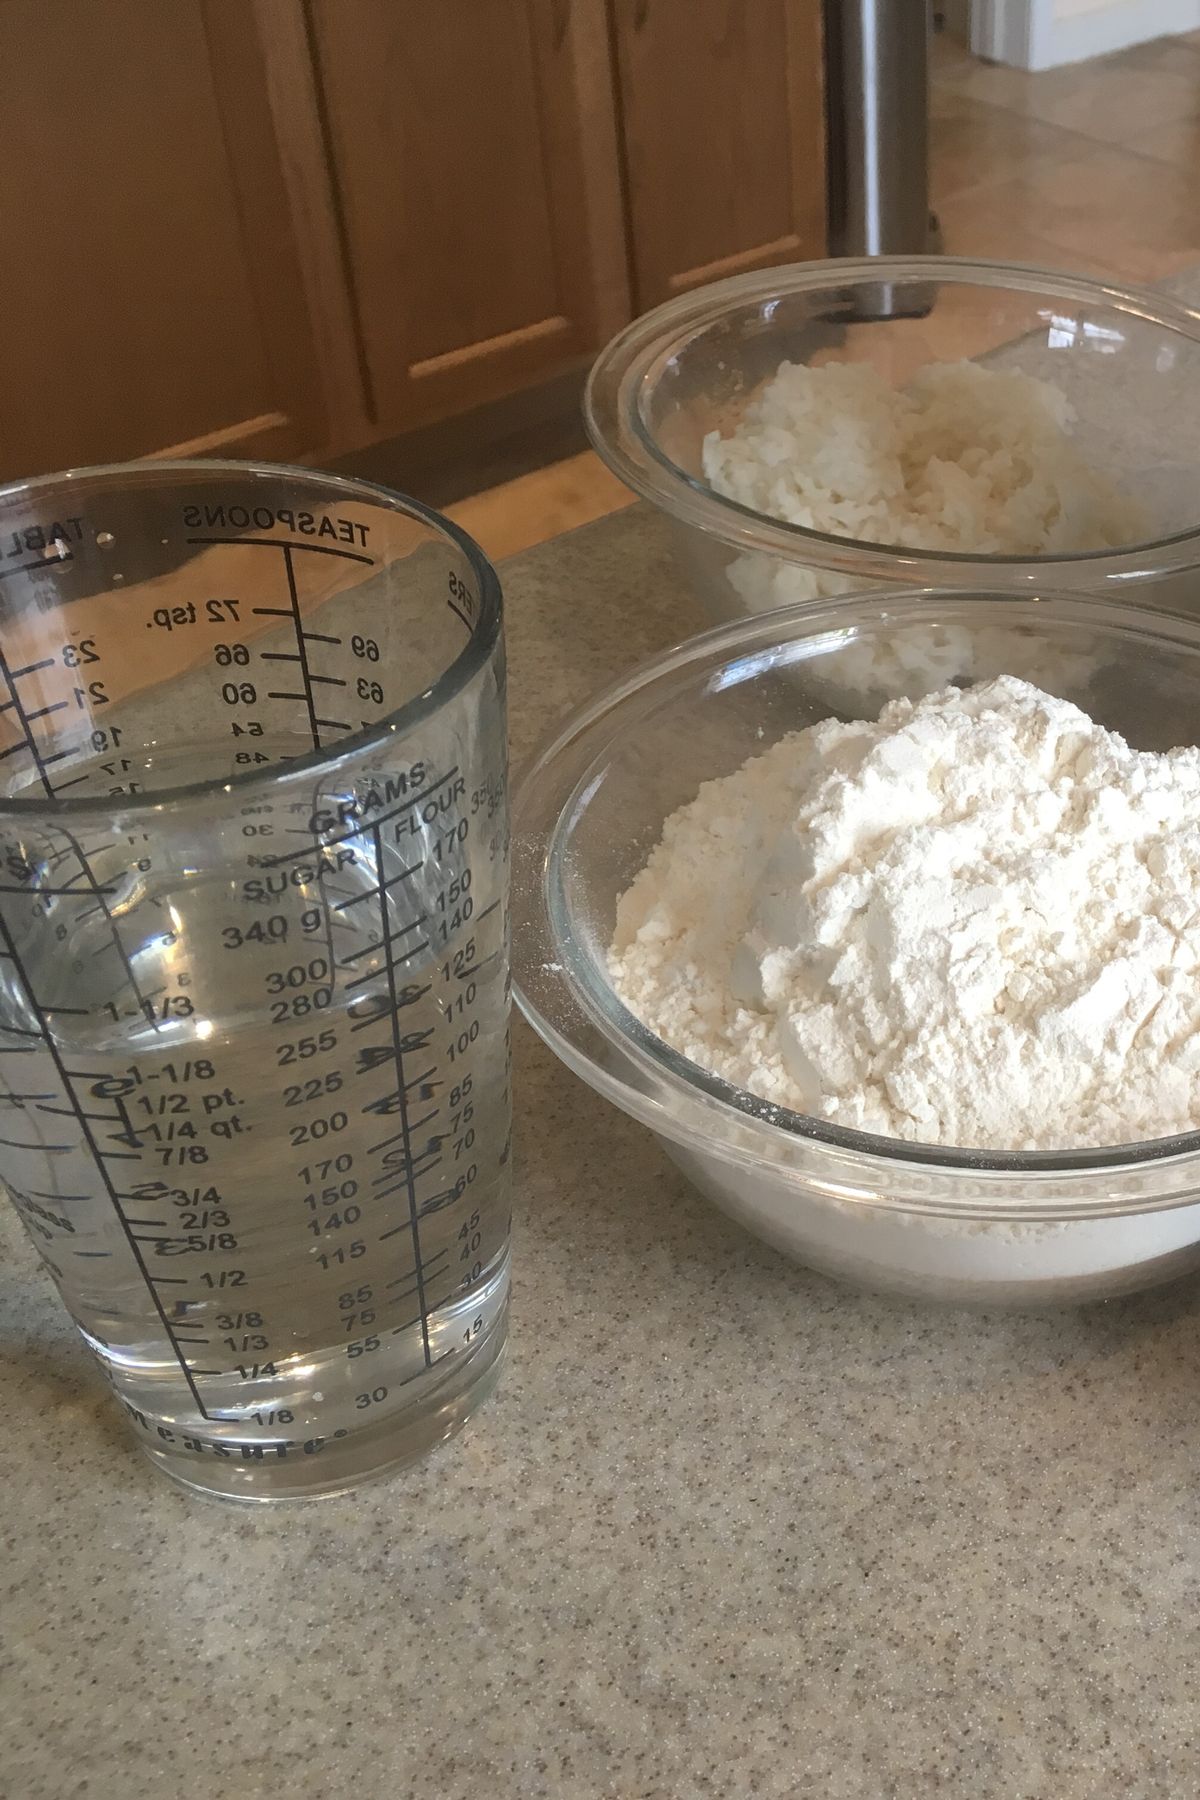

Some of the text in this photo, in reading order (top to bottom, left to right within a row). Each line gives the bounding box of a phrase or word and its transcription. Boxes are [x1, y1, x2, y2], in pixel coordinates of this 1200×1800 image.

[309, 761, 427, 835] GRAMS
[395, 777, 466, 843] FLOUR
[432, 817, 469, 862] 170
[243, 849, 358, 902] SUGAR
[436, 868, 472, 912] 150
[221, 916, 288, 950] 340
[301, 909, 322, 934] g
[438, 897, 474, 941] 140
[441, 937, 477, 982] 125
[265, 958, 328, 994] 300
[104, 996, 195, 1022] 1-1/3
[269, 987, 334, 1025] 280
[443, 982, 477, 1024] 110
[276, 1028, 337, 1066] 255
[446, 1020, 480, 1062] 100
[127, 1059, 216, 1085] 1-1/8
[138, 1087, 245, 1116] 1/2 pt.
[283, 1070, 344, 1108] 225
[449, 1073, 473, 1108] 85
[147, 1114, 253, 1142] 1/4 qt.
[288, 1111, 349, 1147] 200
[450, 1100, 474, 1134] 75
[154, 1146, 209, 1166] 7/8
[452, 1127, 476, 1160] 70
[297, 1153, 354, 1185] 170
[454, 1163, 478, 1193] 60
[169, 1187, 222, 1208] 3/4
[304, 1180, 358, 1212] 150
[179, 1210, 231, 1231] 2/3
[307, 1205, 362, 1237] 140
[457, 1208, 481, 1241] 45
[187, 1233, 238, 1252] 5/8
[316, 1239, 367, 1269] 115
[459, 1231, 482, 1261] 40
[201, 1270, 248, 1290] 1/2
[338, 1284, 374, 1311] 85
[216, 1312, 264, 1331] 3/8
[340, 1308, 377, 1333] 75
[462, 1314, 484, 1343] 15
[223, 1333, 270, 1352] 1/3
[346, 1334, 381, 1359] 55
[234, 1361, 280, 1381] 1/4
[354, 1385, 389, 1410] 30
[250, 1408, 295, 1426] 1/8
